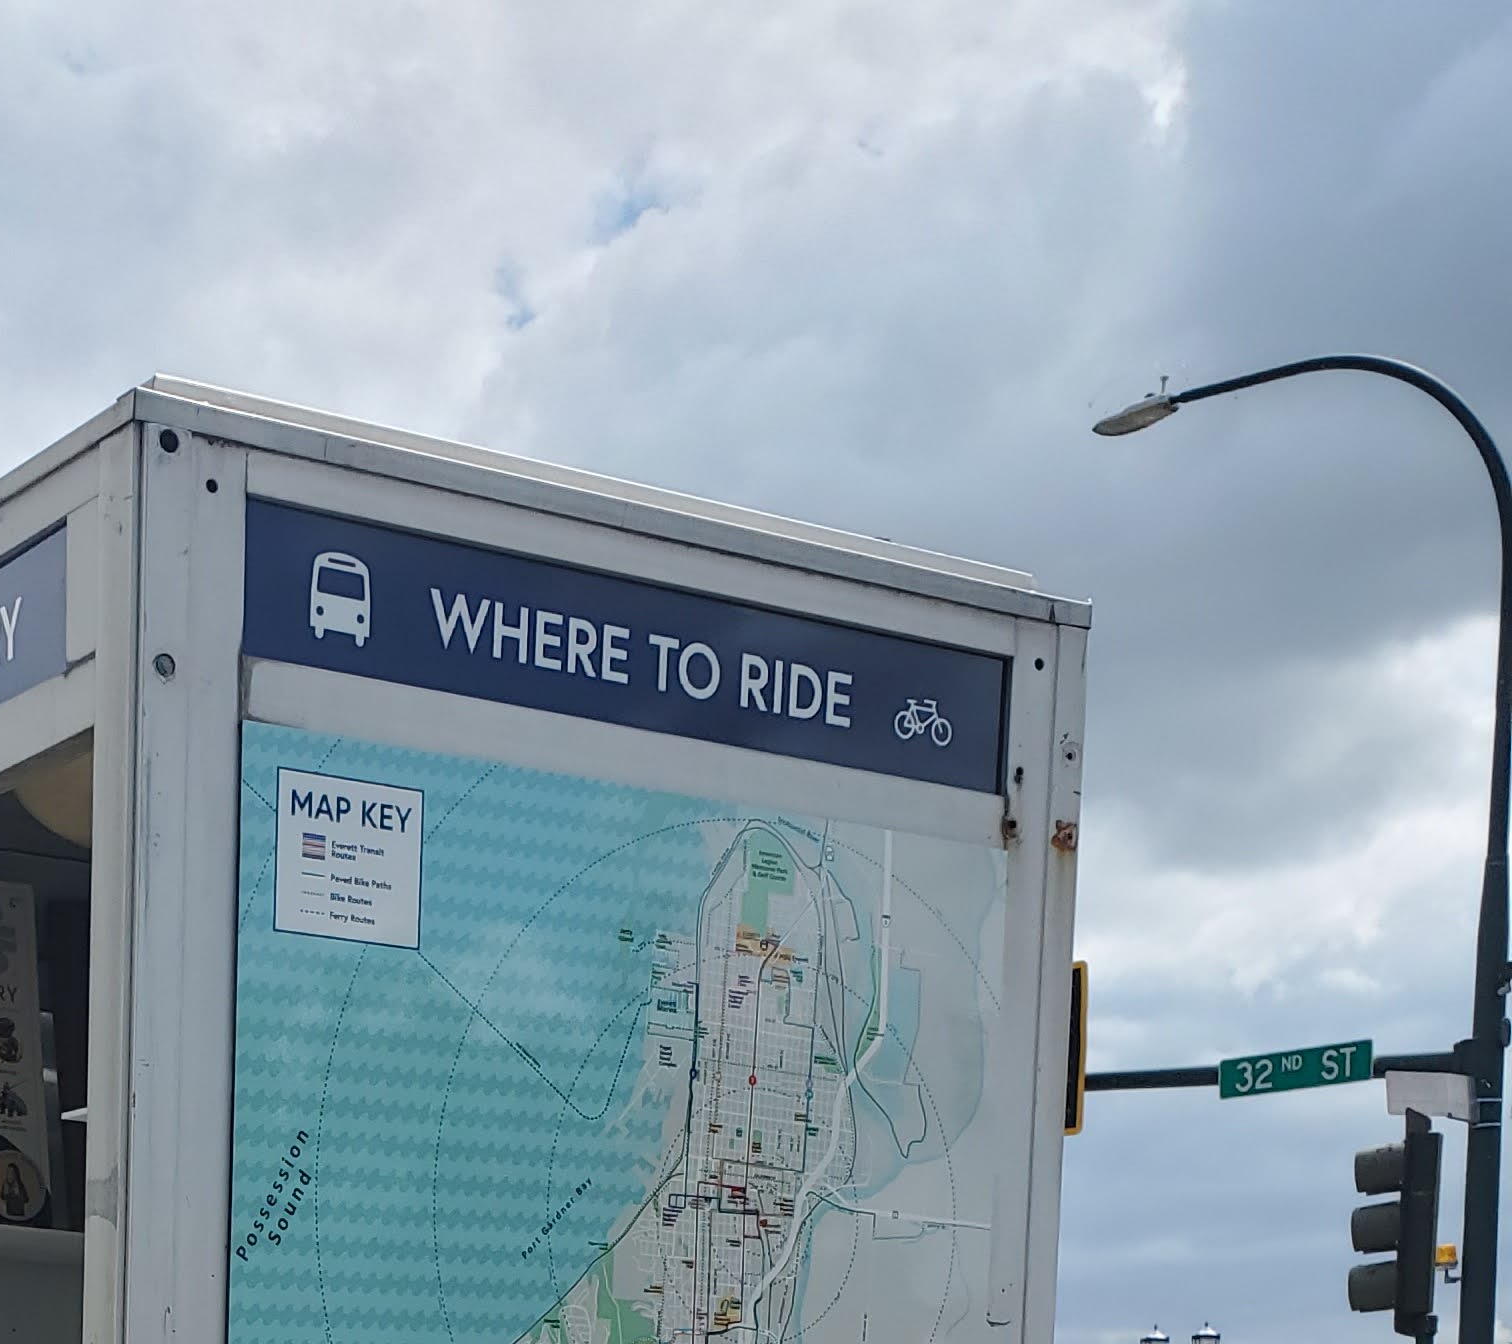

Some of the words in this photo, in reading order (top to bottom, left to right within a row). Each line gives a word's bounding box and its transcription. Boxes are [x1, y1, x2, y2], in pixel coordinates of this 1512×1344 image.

[430, 587, 630, 685] WHERE
[649, 634, 720, 700] TO
[739, 653, 853, 729] RIDE
[291, 789, 352, 823] MAP
[360, 800, 412, 833] KEY
[331, 840, 358, 852] Everett
[359, 844, 385, 857] Transit
[331, 850, 356, 861] Routes
[354, 877, 369, 888] Bike
[371, 880, 392, 890] Paths
[330, 893, 345, 902] Bike
[347, 895, 372, 906] Routes
[329, 911, 348, 923] Ferry
[350, 914, 375, 925] Routes
[1235, 1059, 1273, 1092] 32
[1321, 1047, 1357, 1080] ST
[235, 1130, 309, 1262] Possession
[268, 1168, 312, 1246] Sound
